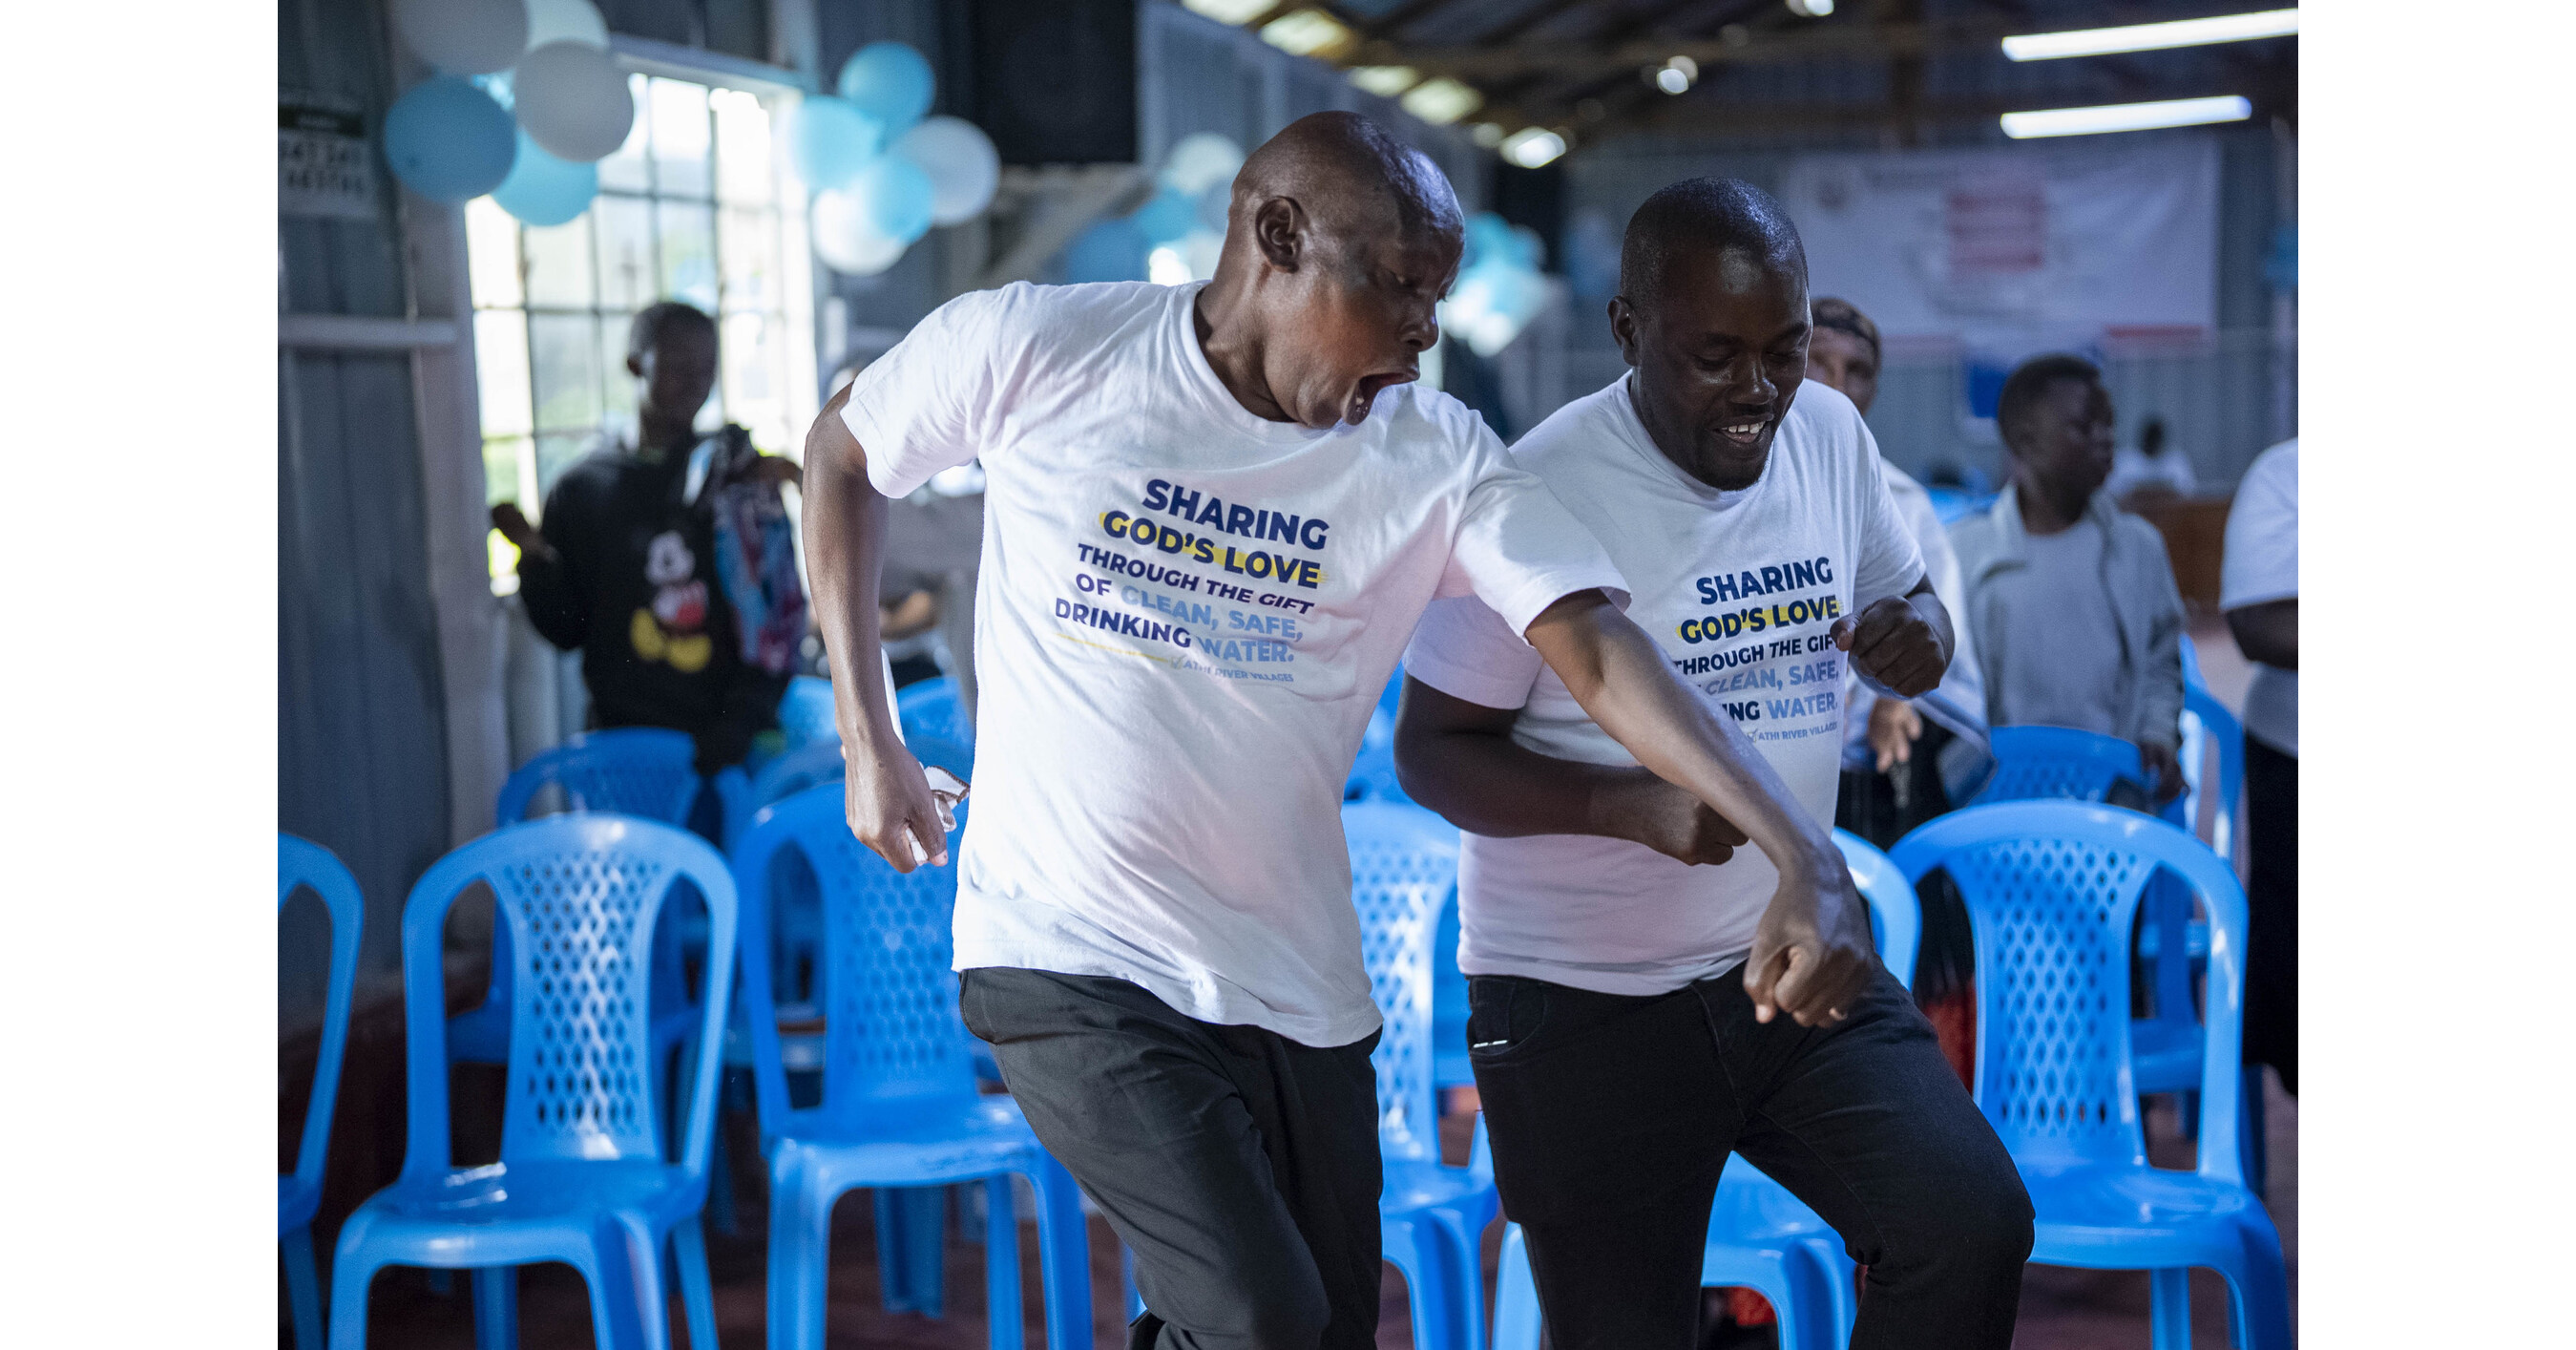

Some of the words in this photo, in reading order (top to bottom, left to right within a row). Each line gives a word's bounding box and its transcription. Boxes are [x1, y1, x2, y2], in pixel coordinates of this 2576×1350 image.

[1141, 479, 1330, 550] SHARING
[1103, 510, 1215, 564] GOD'S
[1224, 546, 1321, 589] LOVE
[1078, 543, 1200, 592] THROUGH
[1206, 580, 1253, 603] THE
[1258, 593, 1314, 615] GIFT
[1696, 557, 1833, 604] SHARING
[1055, 597, 1192, 648] DRINKING
[1195, 636, 1294, 663] WATER.
[1076, 573, 1112, 596] OF
[1120, 585, 1219, 631] CLEAN,
[1227, 610, 1303, 643] SAFE,
[1680, 607, 1766, 644] GOD'S
[1771, 595, 1839, 628] LOVE
[1770, 638, 1802, 659] THE
[1807, 634, 1833, 653] GIF
[1251, 670, 1294, 682] VILLAGES
[1705, 668, 1783, 695] CLEAN,
[1789, 660, 1839, 686] SAFE,
[1758, 730, 1780, 741] ATHI
[1782, 729, 1808, 740] RIVER
